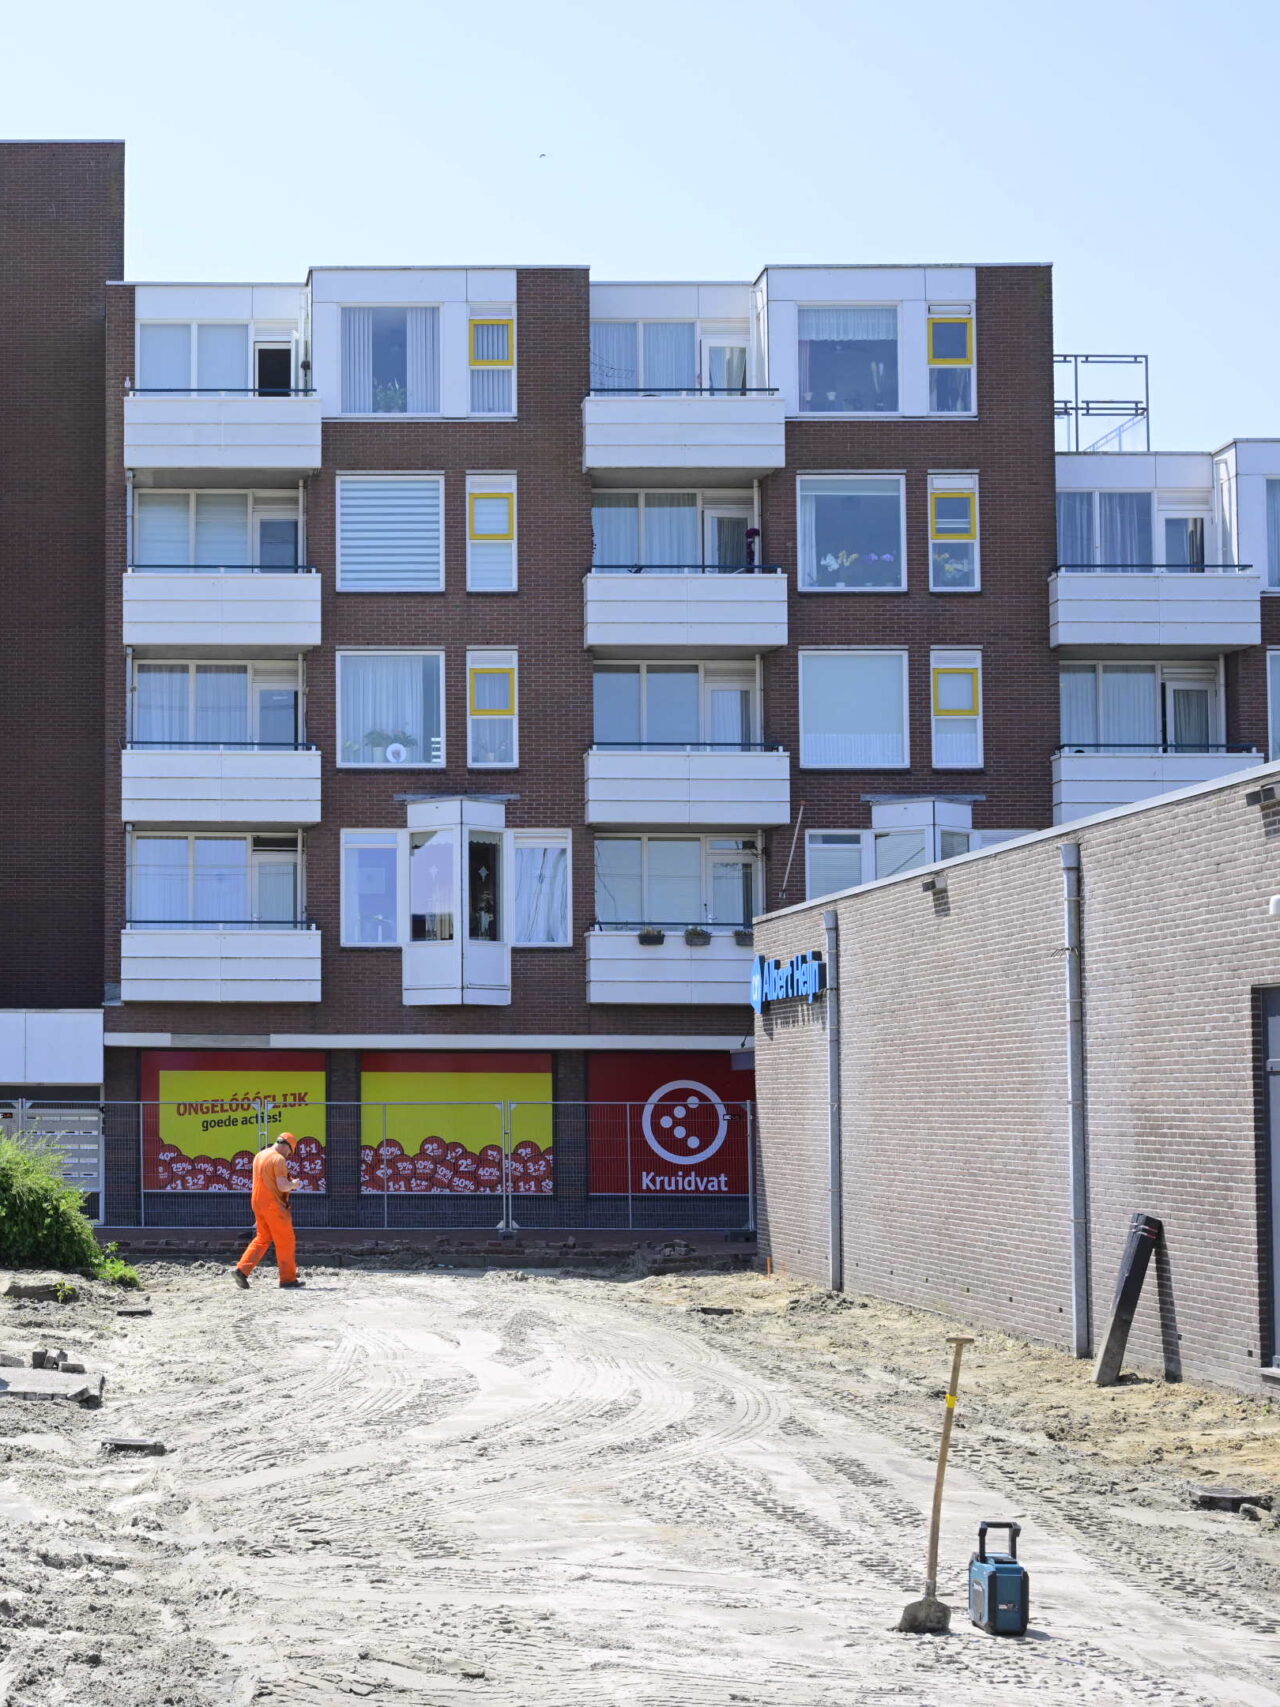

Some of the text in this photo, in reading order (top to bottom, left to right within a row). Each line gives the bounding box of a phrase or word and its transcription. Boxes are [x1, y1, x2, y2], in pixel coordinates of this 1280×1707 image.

[763, 959, 793, 1001] Albert
[793, 950, 819, 1004] Heijn
[202, 1111, 282, 1132] goede acties!
[642, 1171, 728, 1191] Kruidvat
